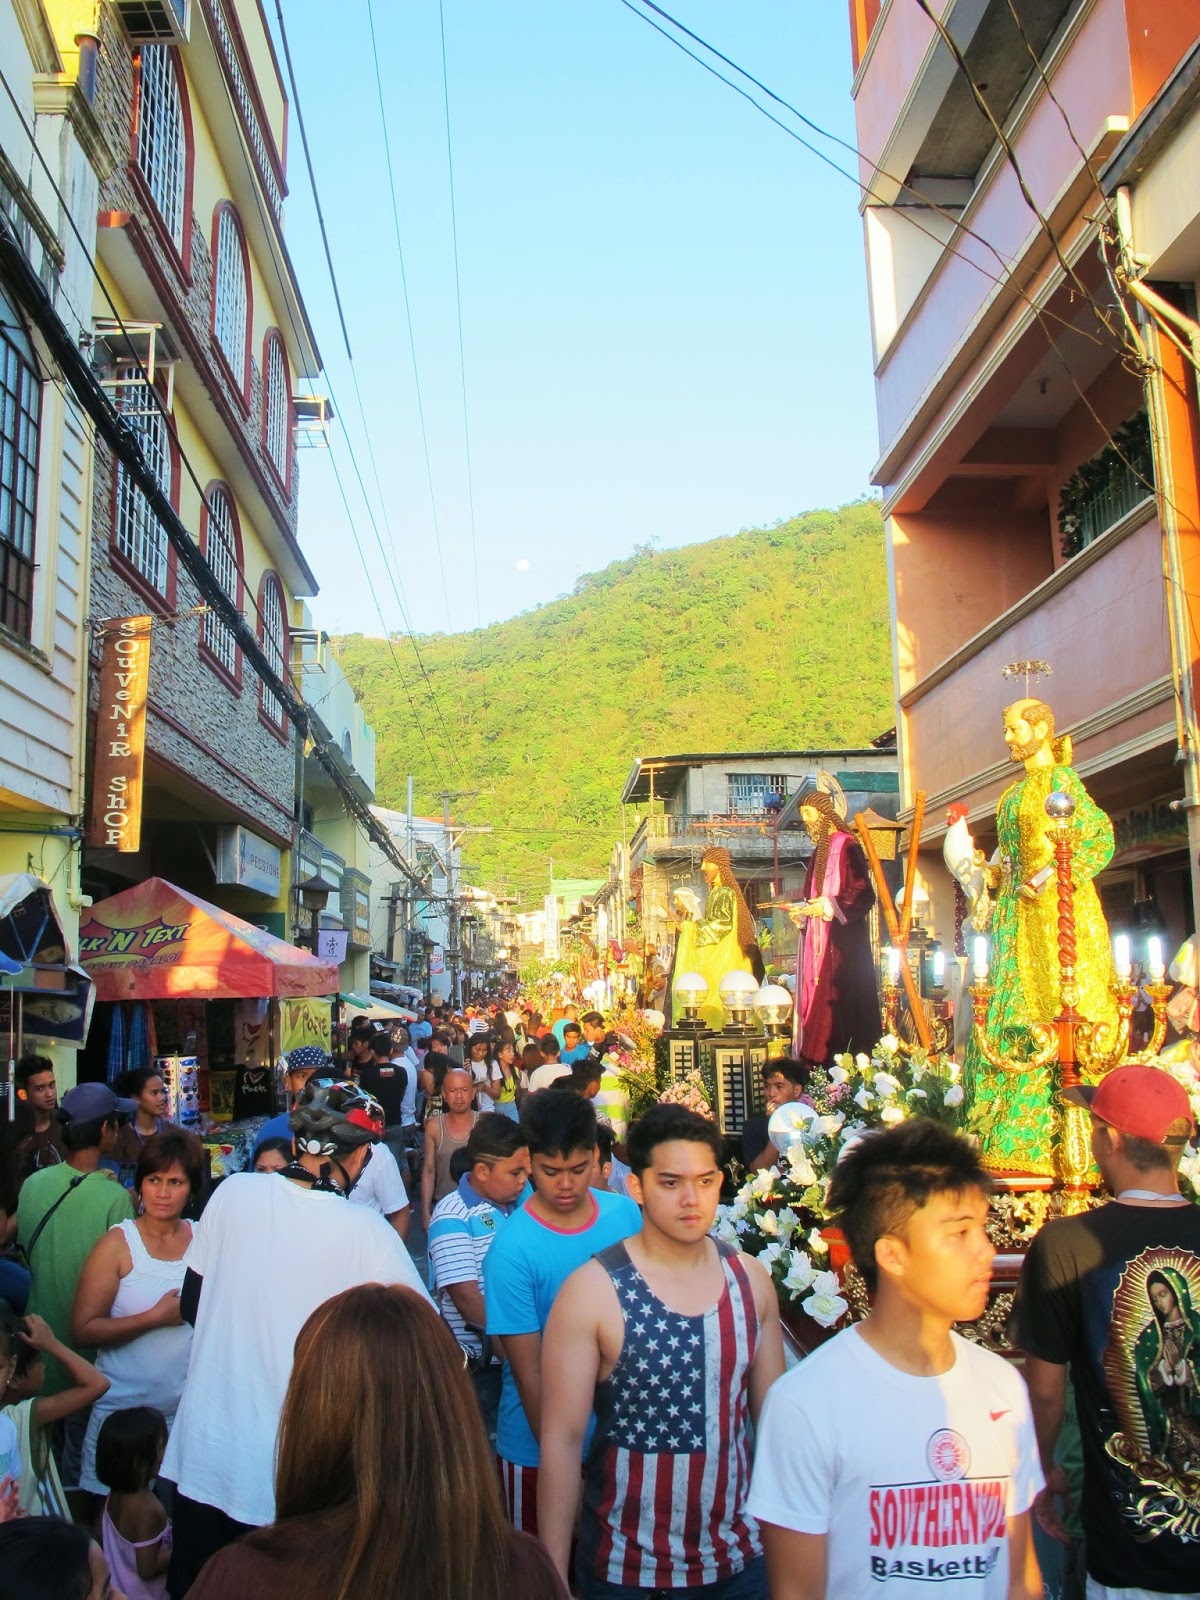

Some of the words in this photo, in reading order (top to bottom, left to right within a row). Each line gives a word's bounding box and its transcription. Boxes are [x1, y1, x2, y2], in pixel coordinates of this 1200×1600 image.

[79, 937, 104, 951] LK
[141, 923, 189, 948] TEXT
[871, 1549, 998, 1577] Basketb
